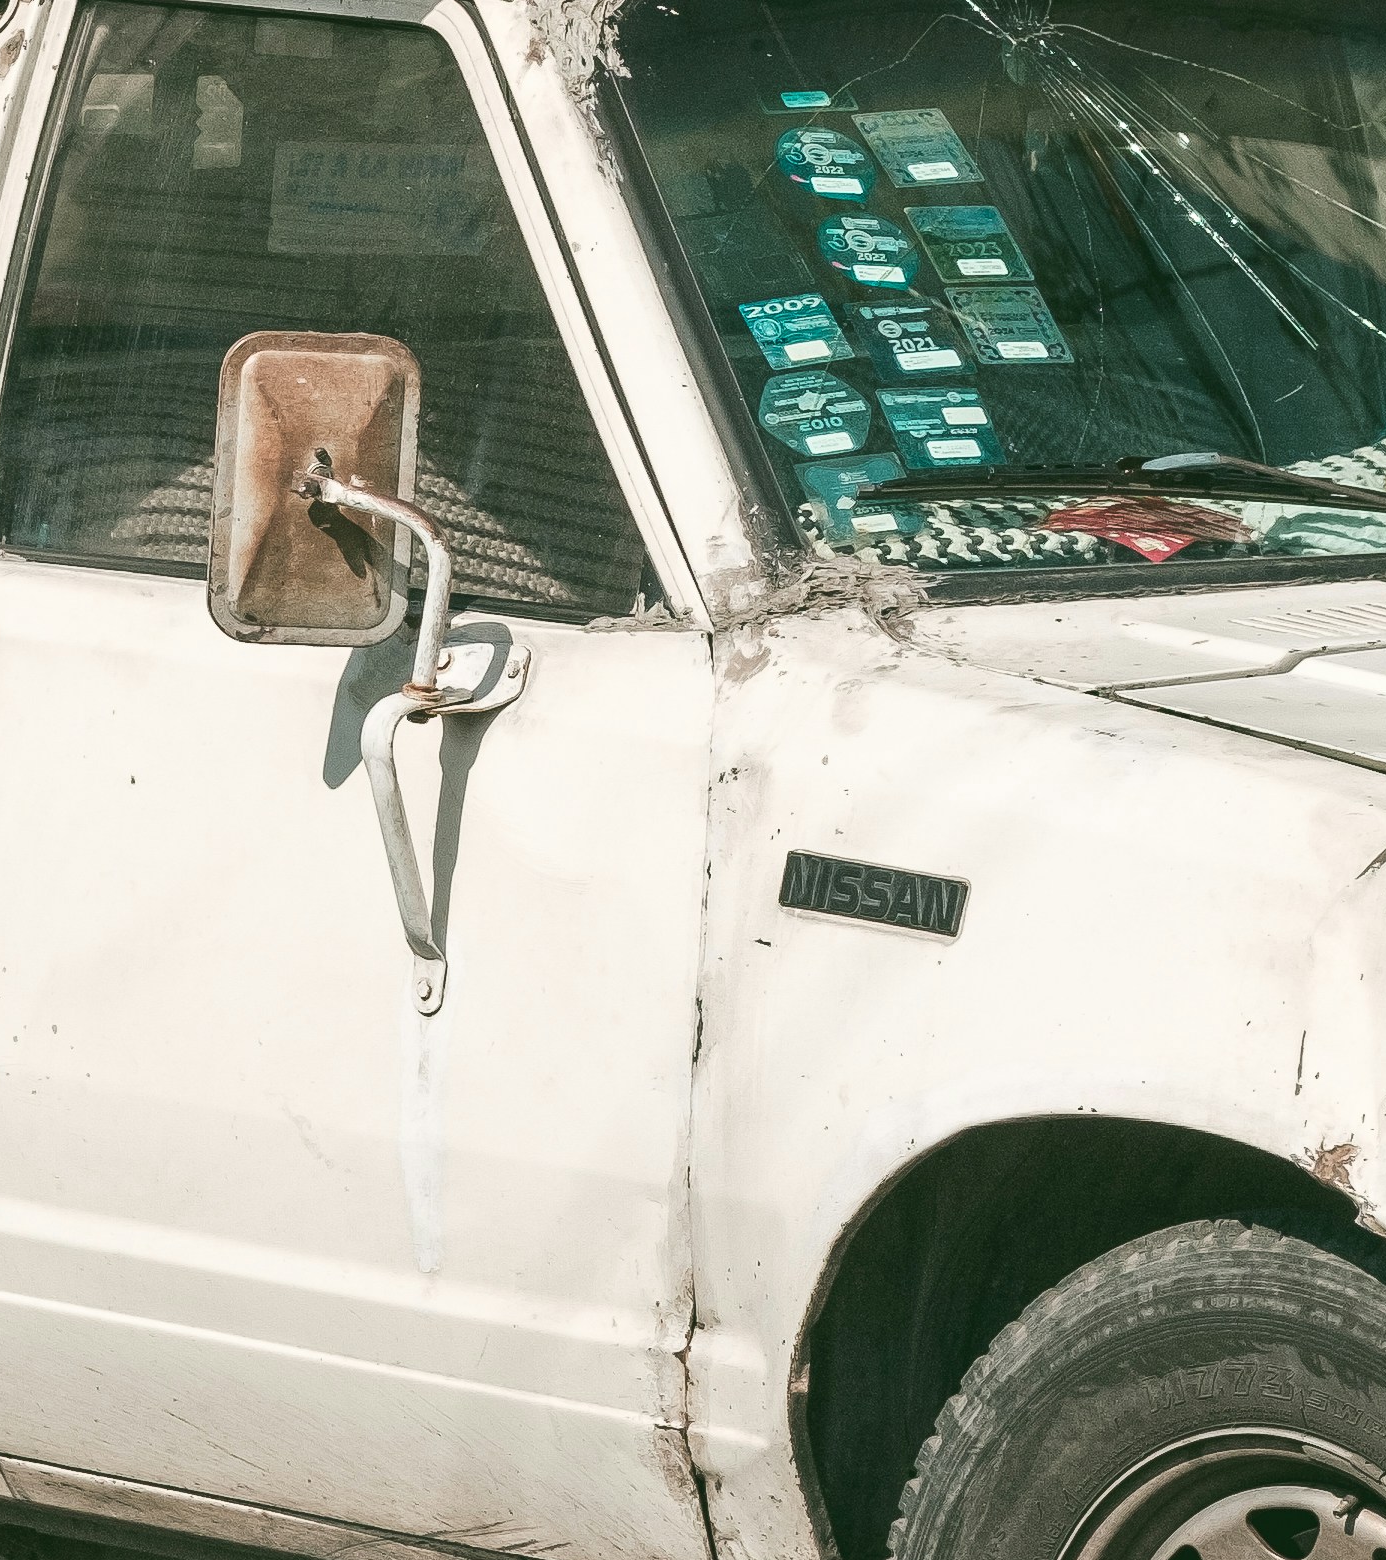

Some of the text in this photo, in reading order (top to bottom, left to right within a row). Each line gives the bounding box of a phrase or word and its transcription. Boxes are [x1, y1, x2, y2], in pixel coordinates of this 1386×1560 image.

[856, 252, 888, 263] 2022
[942, 241, 1003, 257] 2023
[743, 297, 824, 319] 2009
[888, 336, 940, 354] 2021
[798, 416, 844, 432] 2010
[784, 853, 960, 932] NISSAN
